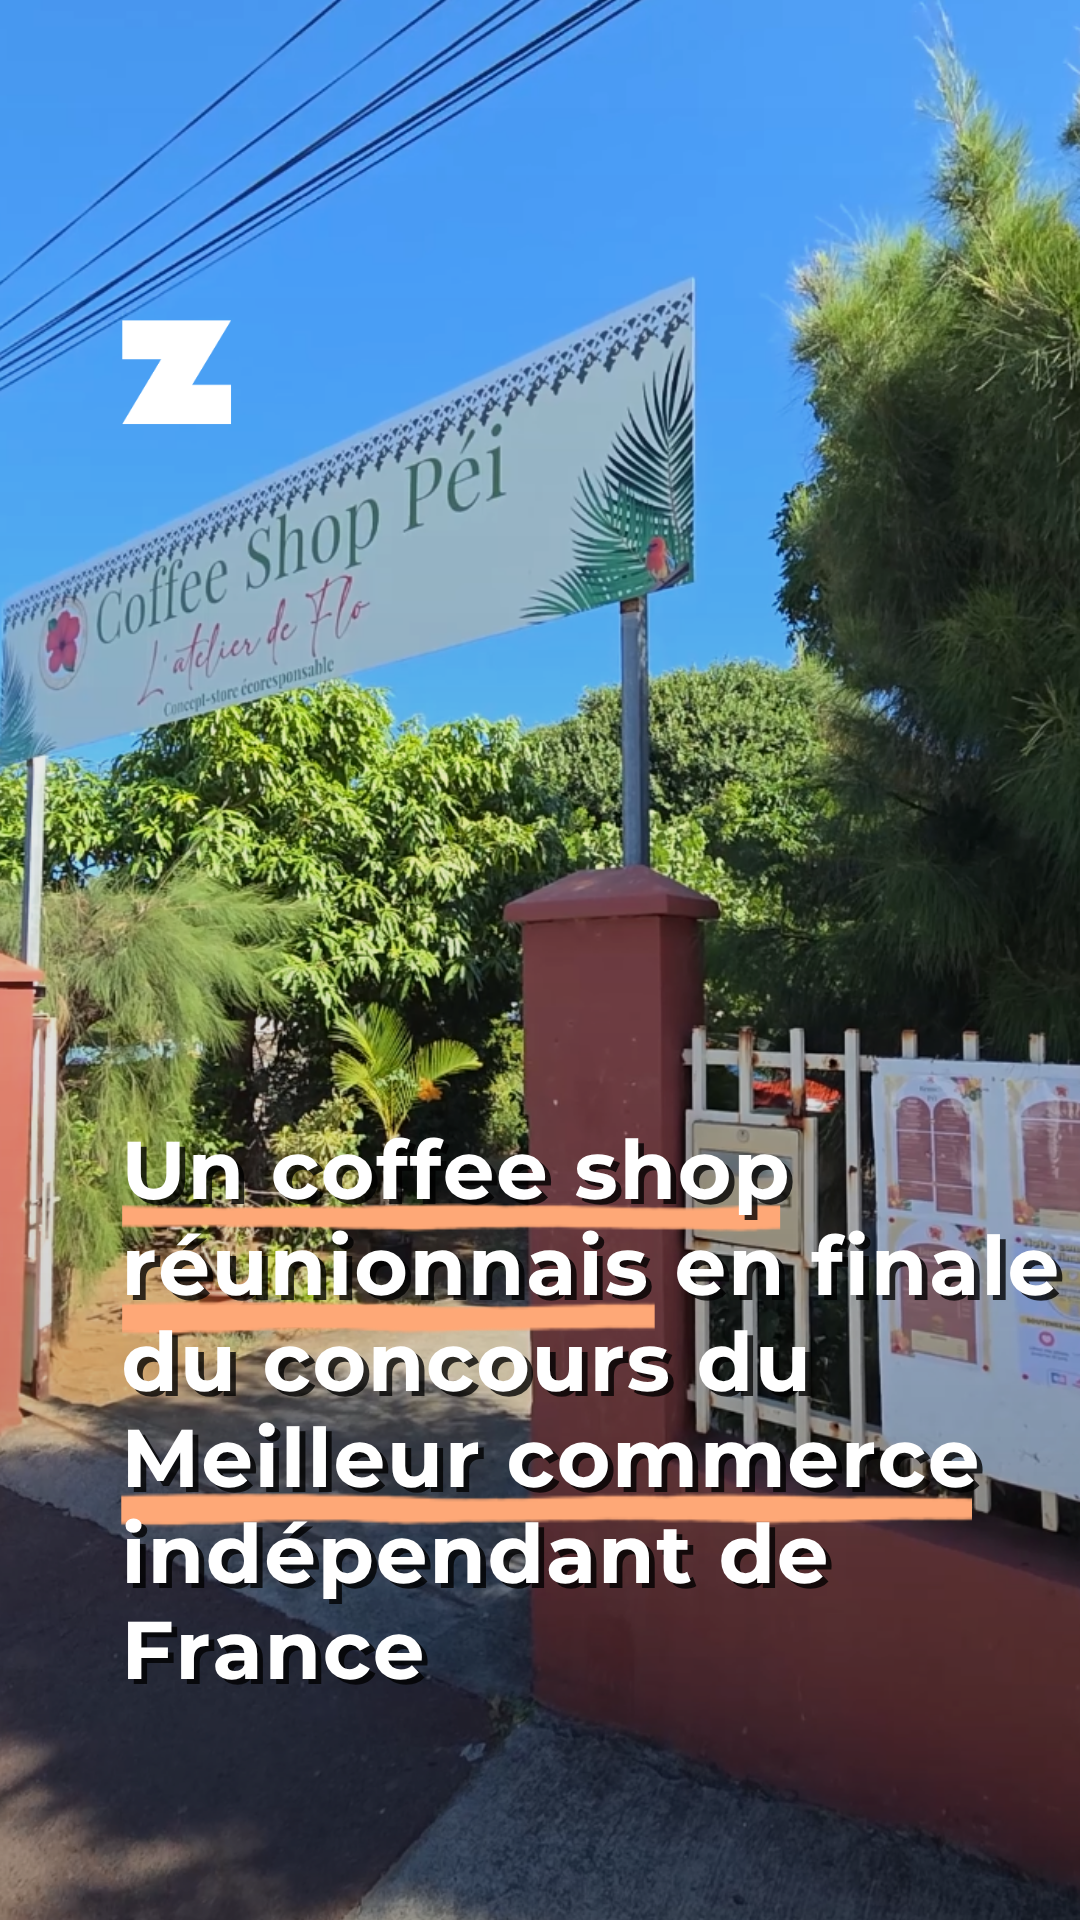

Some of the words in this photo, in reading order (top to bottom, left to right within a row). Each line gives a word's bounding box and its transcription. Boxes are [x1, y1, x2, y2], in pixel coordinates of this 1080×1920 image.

[97, 552, 228, 645] Coffee
[246, 496, 380, 590] Shop
[404, 423, 506, 533] Péi
[138, 623, 260, 706] L'atelier
[267, 598, 297, 664] de
[306, 575, 370, 657] Flo
[163, 685, 240, 718] Concept-store
[241, 656, 335, 699] écoresponsable
